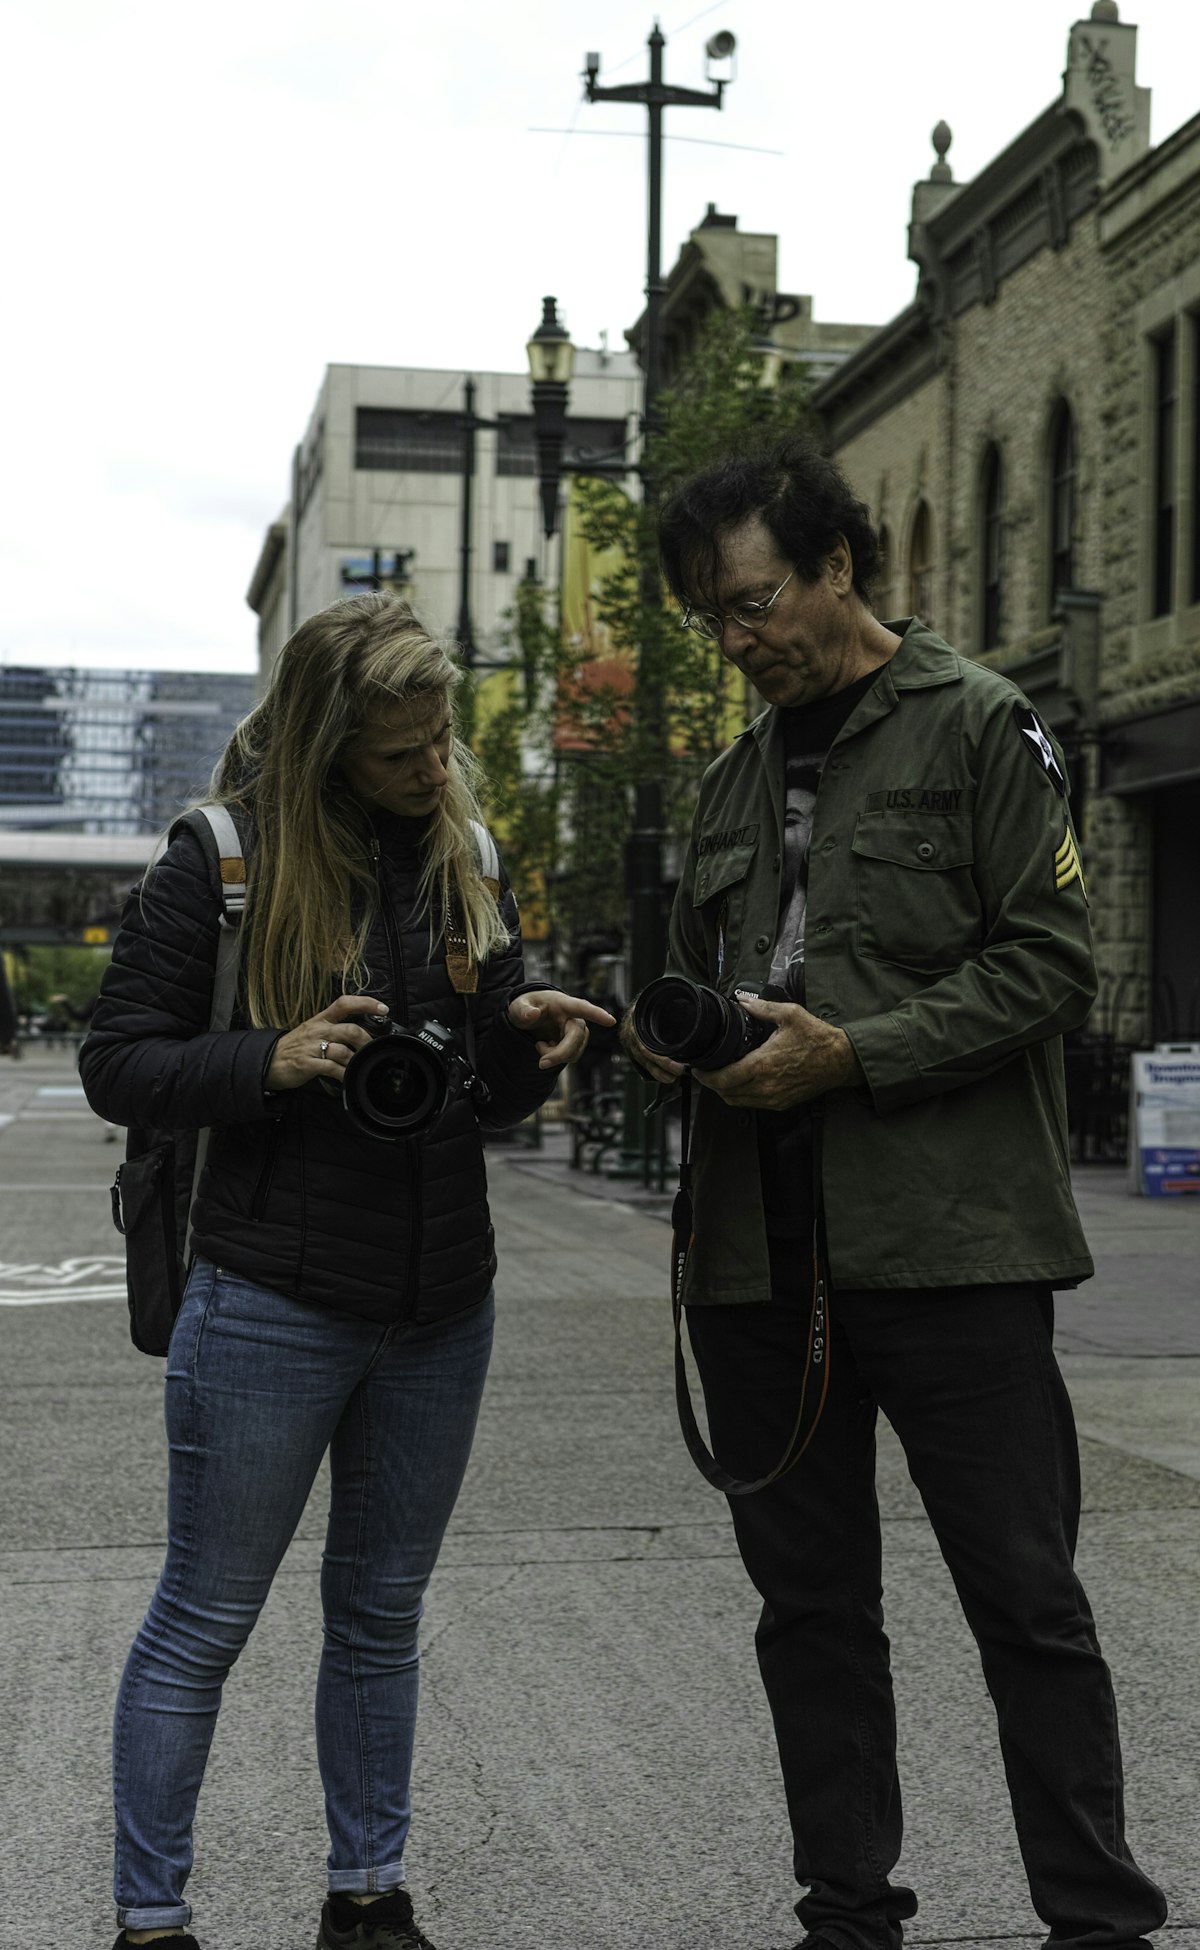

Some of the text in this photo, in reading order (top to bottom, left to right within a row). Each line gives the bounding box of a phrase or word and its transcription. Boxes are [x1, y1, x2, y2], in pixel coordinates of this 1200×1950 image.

[886, 789, 961, 812] U.S. ARMY
[418, 1030, 445, 1051] Nikon
[812, 1336, 824, 1364] 6D
